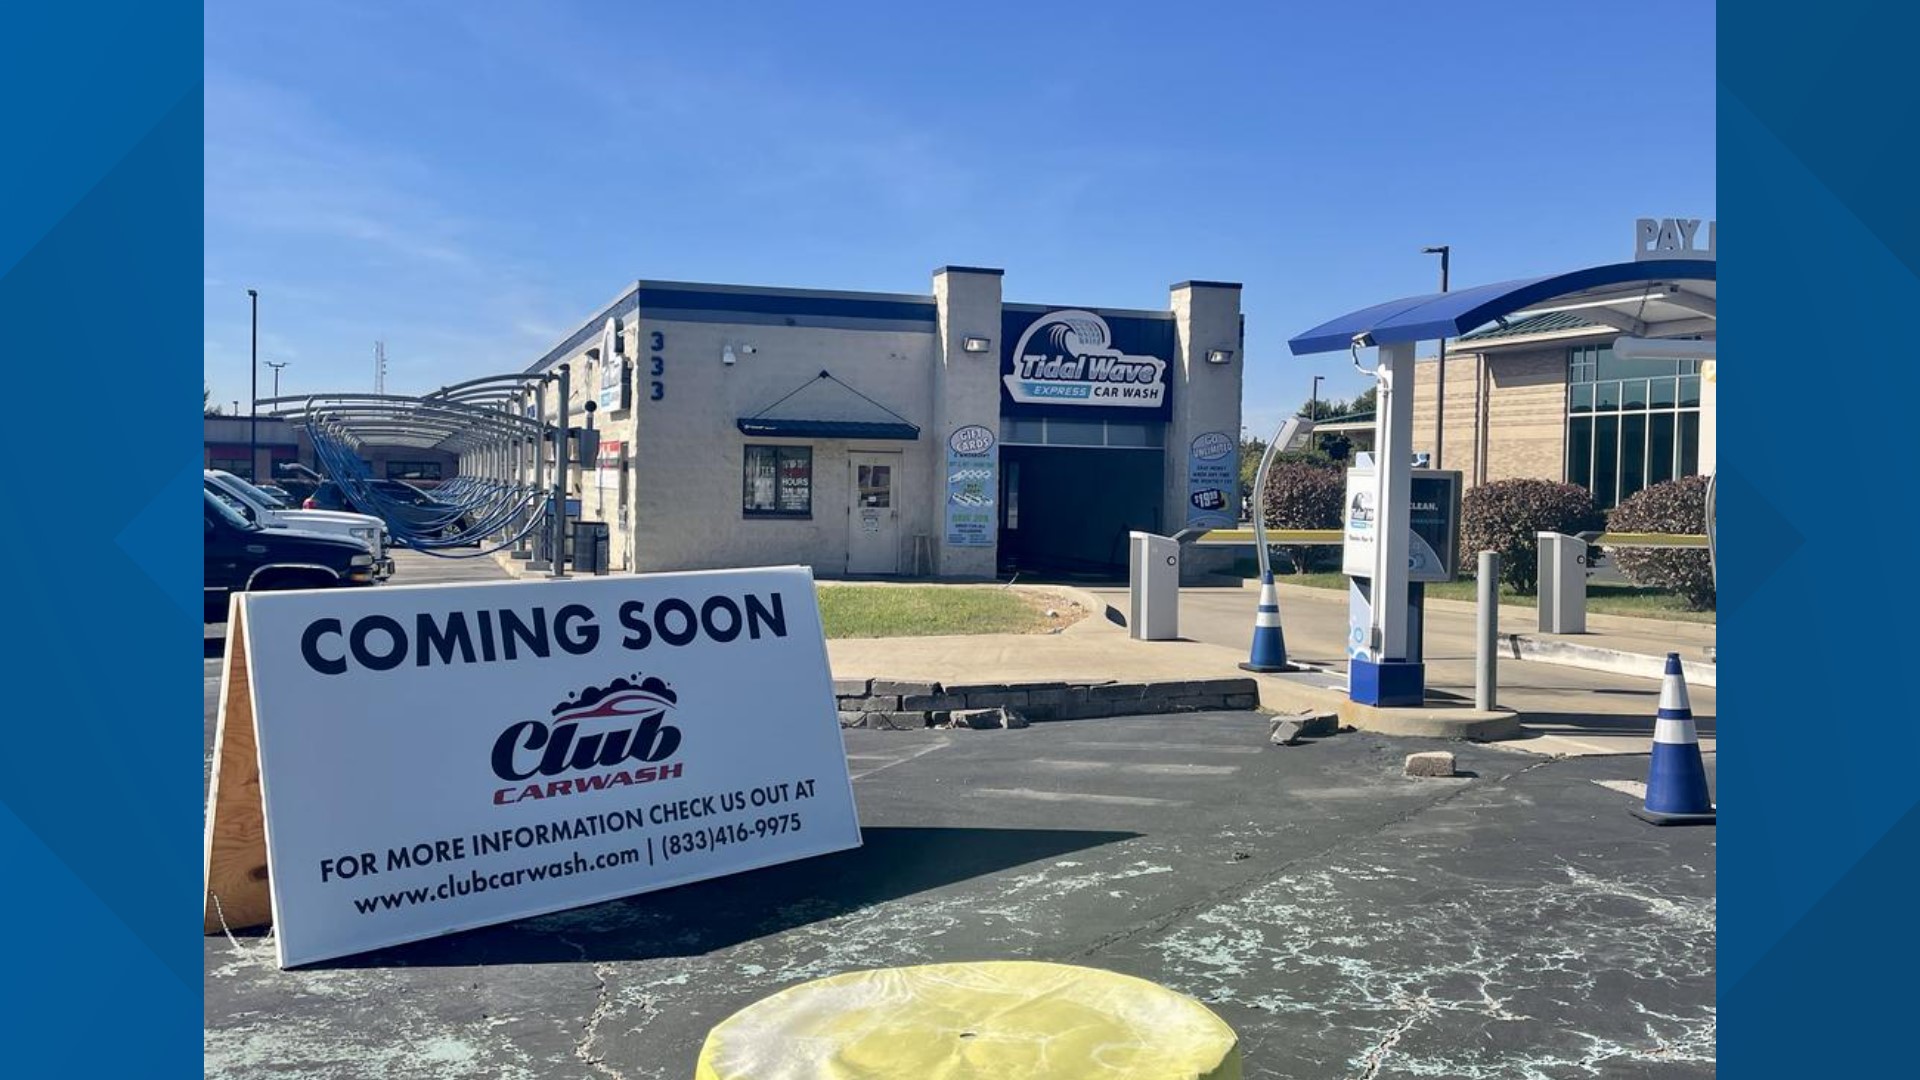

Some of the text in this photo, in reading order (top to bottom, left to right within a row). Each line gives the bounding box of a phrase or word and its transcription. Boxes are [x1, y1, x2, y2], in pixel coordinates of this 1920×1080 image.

[1636, 218, 1701, 252] PAY
[1021, 354, 1157, 383] Tidal Wave
[1033, 386, 1158, 399] EXPRESS CAR WASH
[956, 438, 989, 451] CARDS
[960, 428, 983, 440] GIFT
[782, 478, 809, 486] HOURS
[301, 593, 787, 675] COMING SOON
[490, 709, 682, 781] Club
[493, 763, 684, 806] CARWASH
[320, 779, 816, 883] FOR MORE INFORMATION CHECK US OUT AT
[354, 848, 639, 914] www.clubcarwash.com
[661, 813, 802, 861] (833)416-9975
